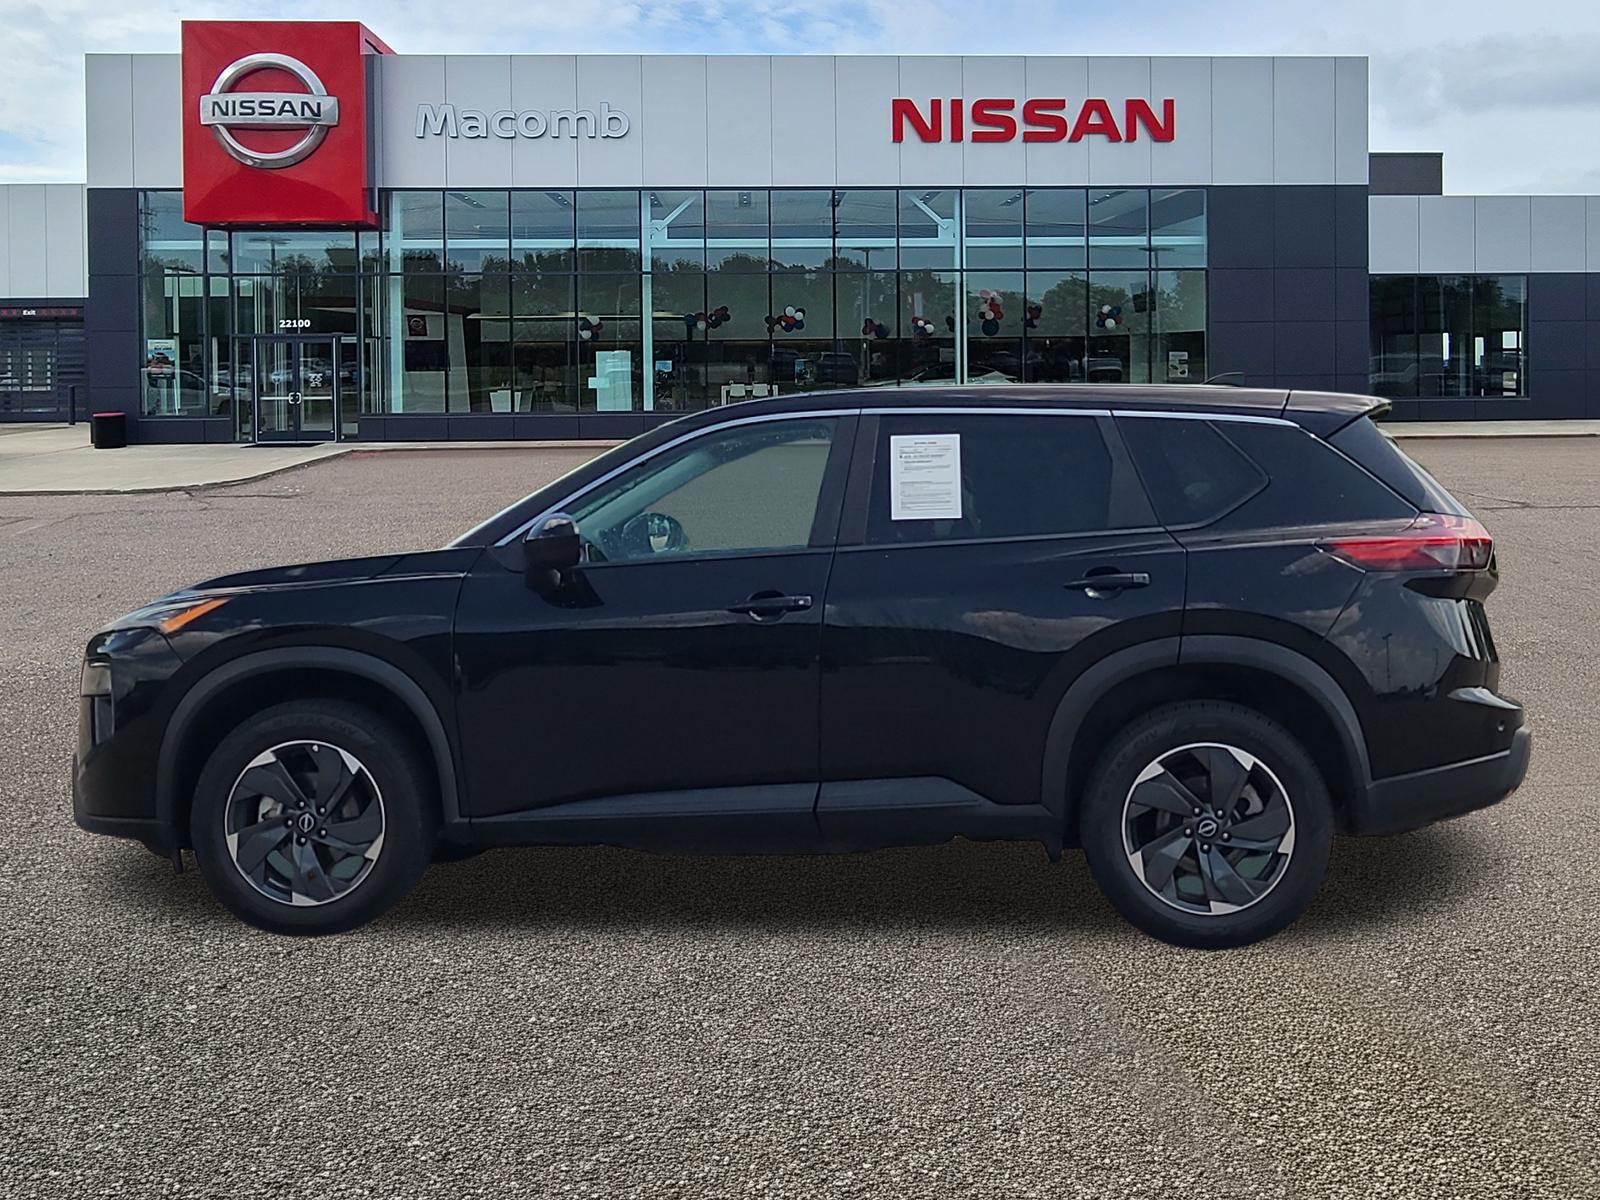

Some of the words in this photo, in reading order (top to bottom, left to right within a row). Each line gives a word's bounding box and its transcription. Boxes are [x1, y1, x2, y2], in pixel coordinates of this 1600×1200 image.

[212, 100, 321, 117] NISSAN
[415, 101, 630, 139] Macomb
[892, 98, 1175, 142] NISSAN
[279, 319, 311, 328] 22100
